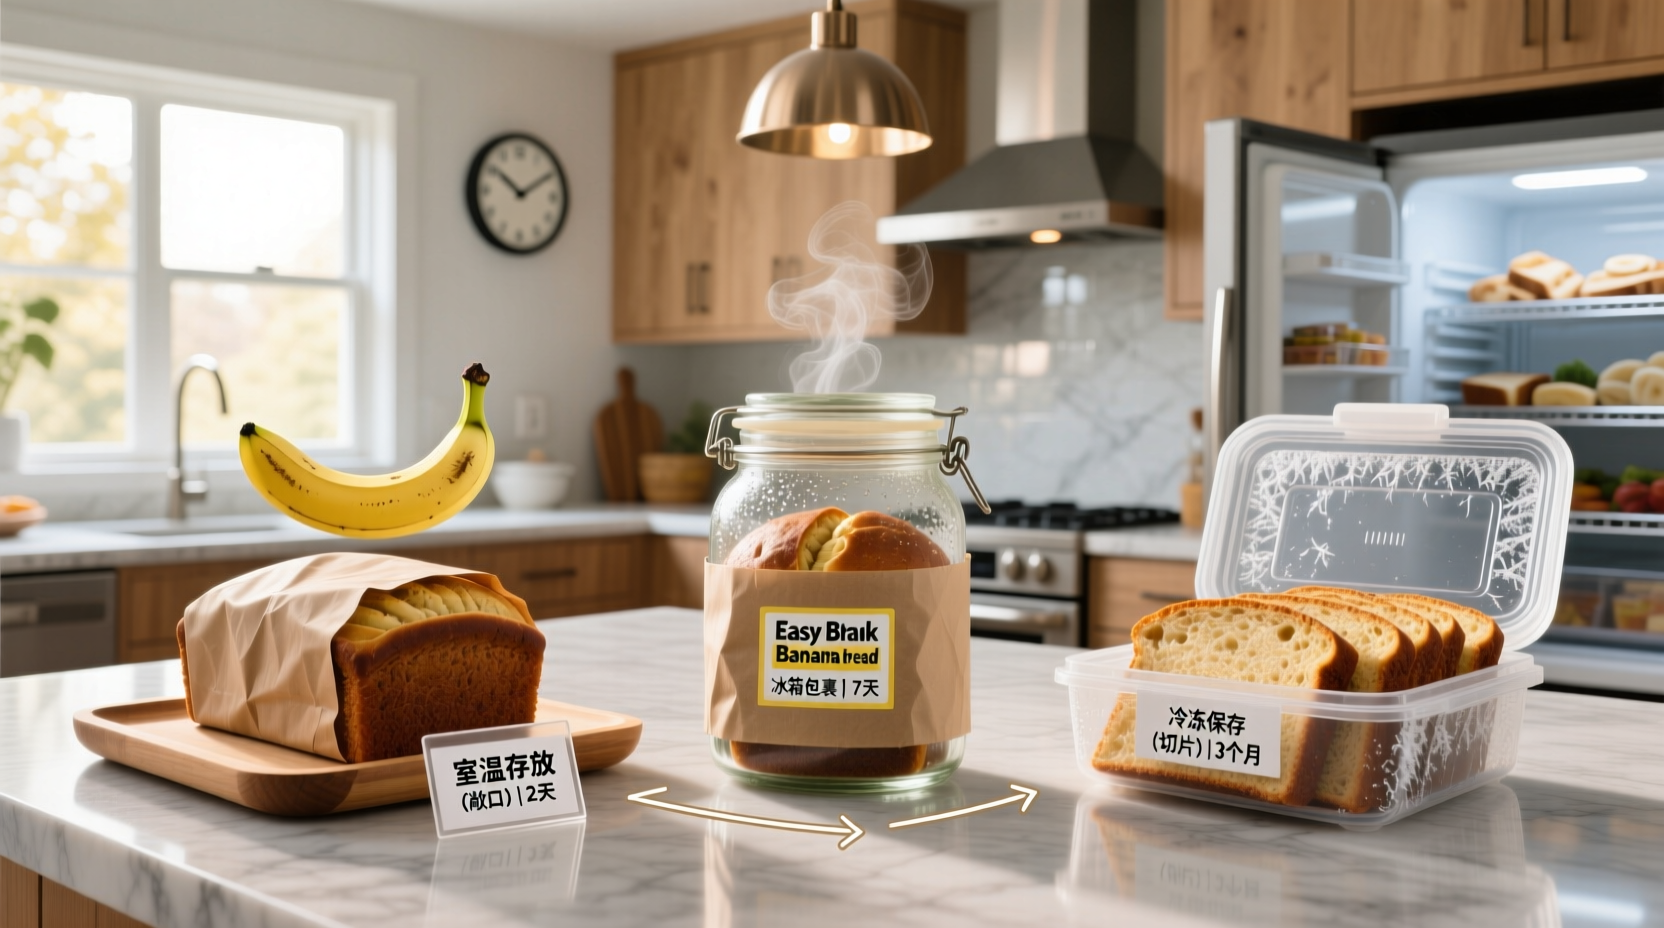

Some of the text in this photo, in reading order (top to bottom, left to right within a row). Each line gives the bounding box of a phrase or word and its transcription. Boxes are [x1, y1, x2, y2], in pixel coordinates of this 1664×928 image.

[775, 620, 822, 646] Easy
[1168, 706, 1246, 736] 冷冻保存
[453, 749, 556, 787] 室温存放
